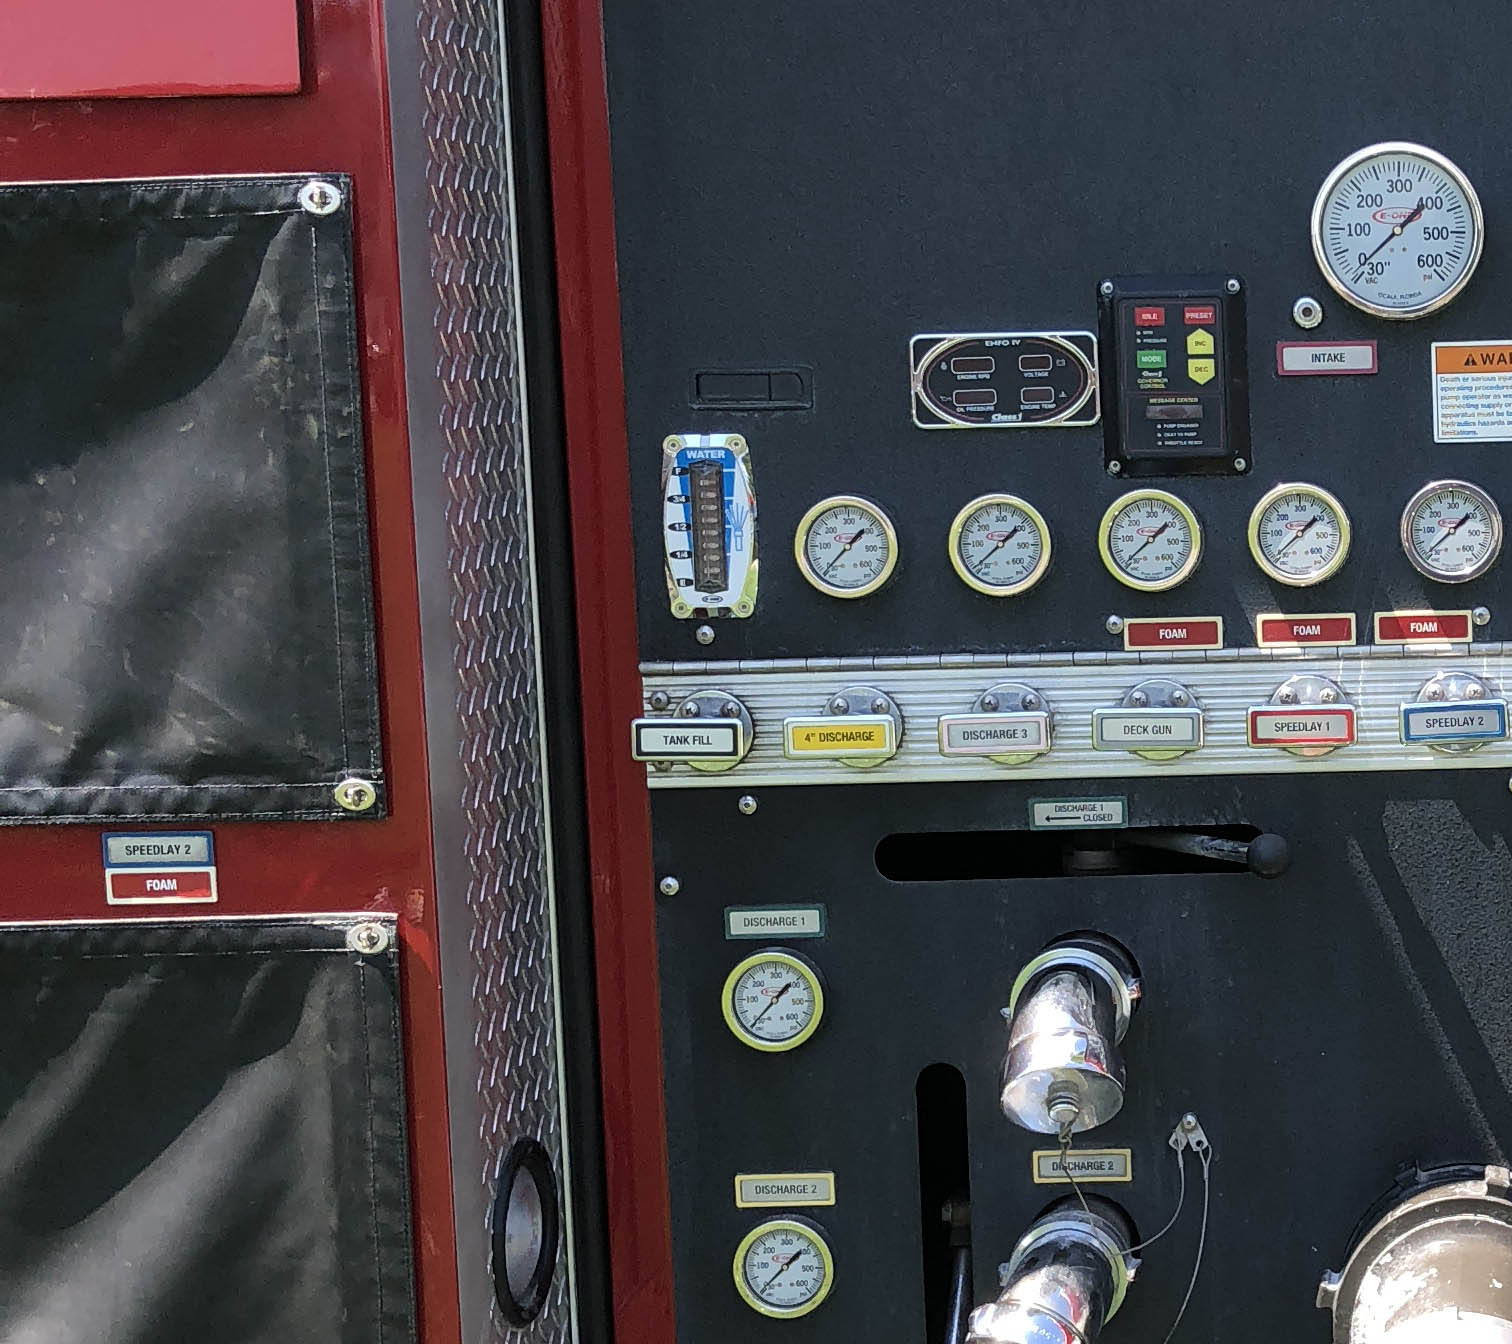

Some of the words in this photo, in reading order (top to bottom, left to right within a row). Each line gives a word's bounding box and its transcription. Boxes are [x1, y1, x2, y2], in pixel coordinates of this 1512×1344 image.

[1386, 179, 1412, 193] 300
[1356, 194, 1383, 208] 200
[1417, 196, 1443, 210] 400
[1346, 222, 1371, 237] 100
[1423, 226, 1449, 240] 500
[1358, 252, 1366, 266] 0
[1417, 254, 1443, 268] 600
[1423, 273, 1433, 281] psi
[1311, 352, 1346, 362] INTAKE
[686, 450, 726, 459] WATER
[1293, 625, 1321, 636] FOAM
[1410, 621, 1438, 633] FOAM
[1159, 628, 1187, 639] FOAM
[1274, 721, 1323, 733] SPEEDLAY
[1325, 721, 1330, 731] 1
[1425, 717, 1475, 729] SPEEDLAY
[1477, 716, 1484, 726] 2
[962, 729, 1019, 741] DISCHARGE
[1020, 728, 1028, 738] 3
[1123, 725, 1149, 735] DECK
[1151, 725, 1172, 735] GUN
[663, 735, 690, 746] TANK
[692, 735, 712, 745] FILL
[818, 731, 875, 743] DISCHARGE
[1054, 804, 1097, 813] DISCHARGE
[1100, 803, 1104, 811] 1
[1083, 813, 1113, 822] CLOSED
[125, 845, 180, 856] SPEEDLAY
[184, 844, 191, 854] 2
[146, 879, 177, 891] FOAM
[743, 917, 797, 927] DISCHARGE
[800, 917, 805, 926] 1
[1107, 1161, 1114, 1170] 2
[755, 1185, 809, 1195] DISCHARGE
[811, 1184, 817, 1193] 2
